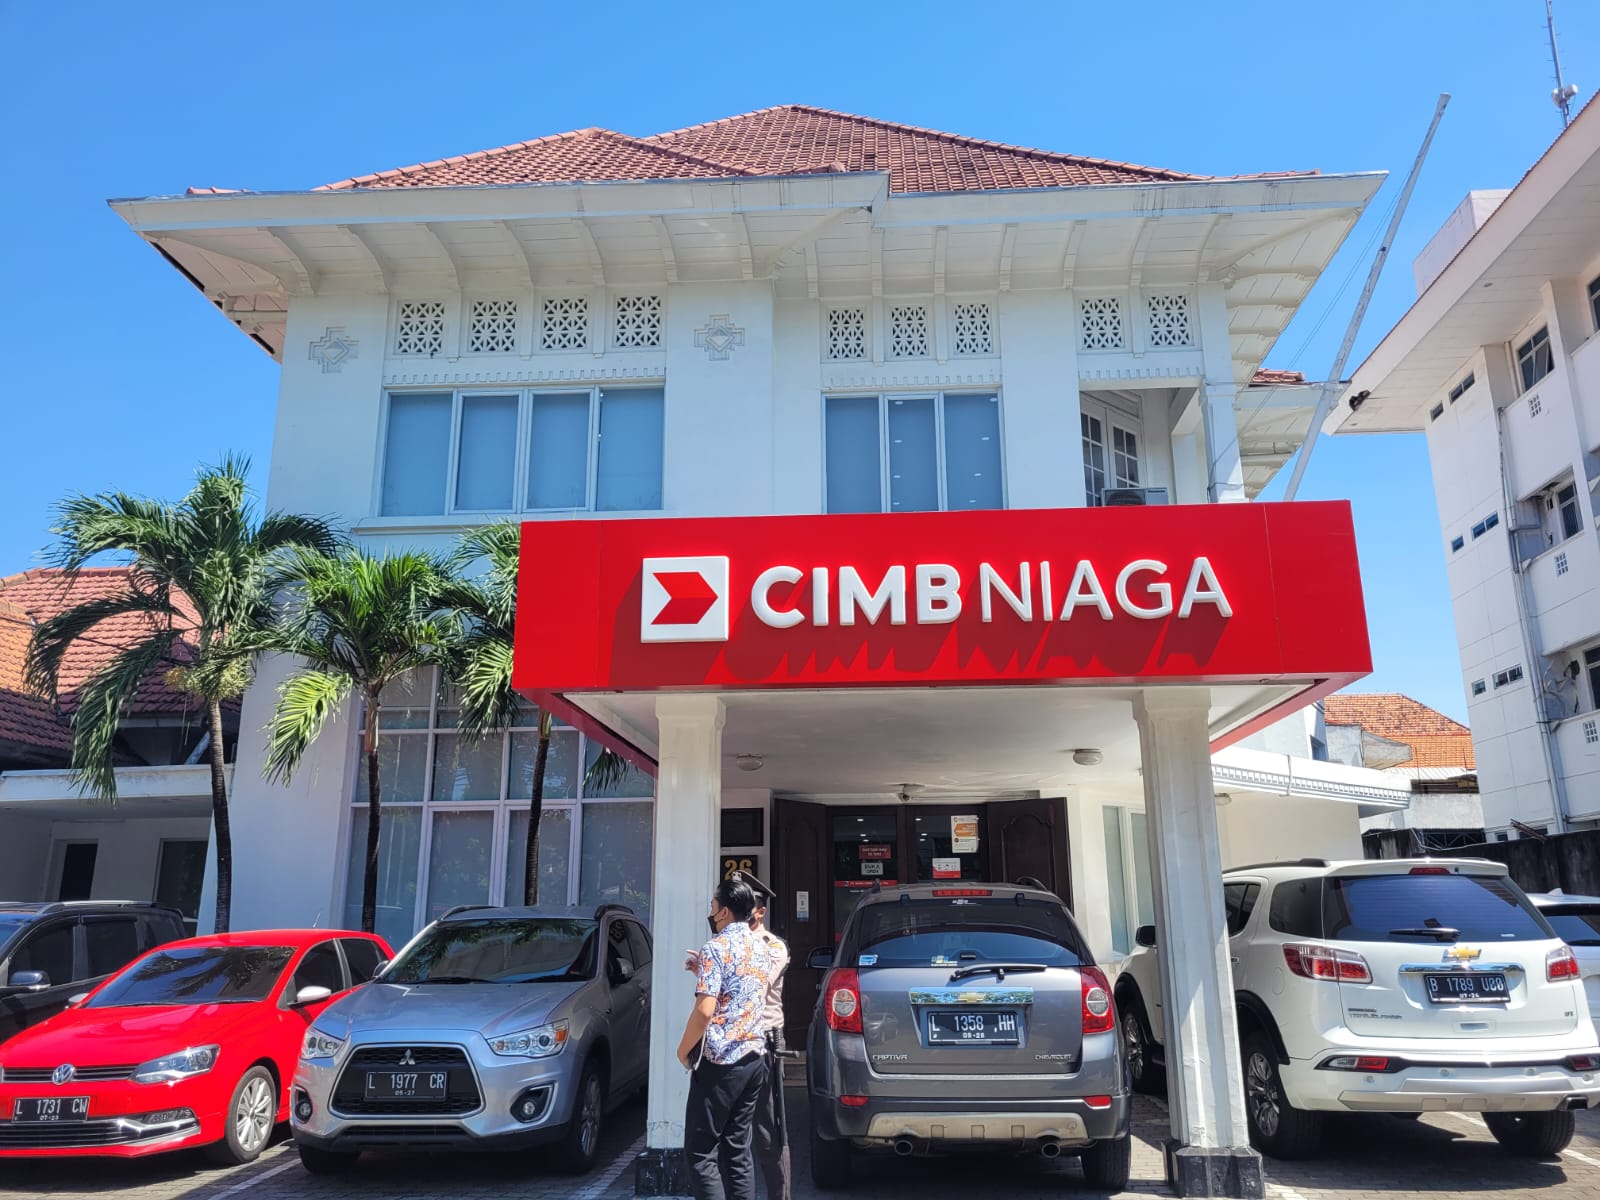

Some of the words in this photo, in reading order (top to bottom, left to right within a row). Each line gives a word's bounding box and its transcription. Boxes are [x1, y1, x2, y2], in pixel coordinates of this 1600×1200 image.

[751, 563, 962, 628] CIMB
[980, 556, 1233, 623] NIAGA
[725, 859, 752, 880] 26
[1429, 978, 1438, 992] B
[1447, 978, 1474, 992] 1789
[931, 1016, 941, 1031] L
[954, 1016, 984, 1031] 1358
[998, 1015, 1016, 1031] HH
[368, 1074, 376, 1088] L
[390, 1074, 418, 1089] 1977
[429, 1074, 444, 1089] CR
[16, 1100, 23, 1115] L
[37, 1099, 61, 1115] 1731
[72, 1098, 88, 1113] CW
